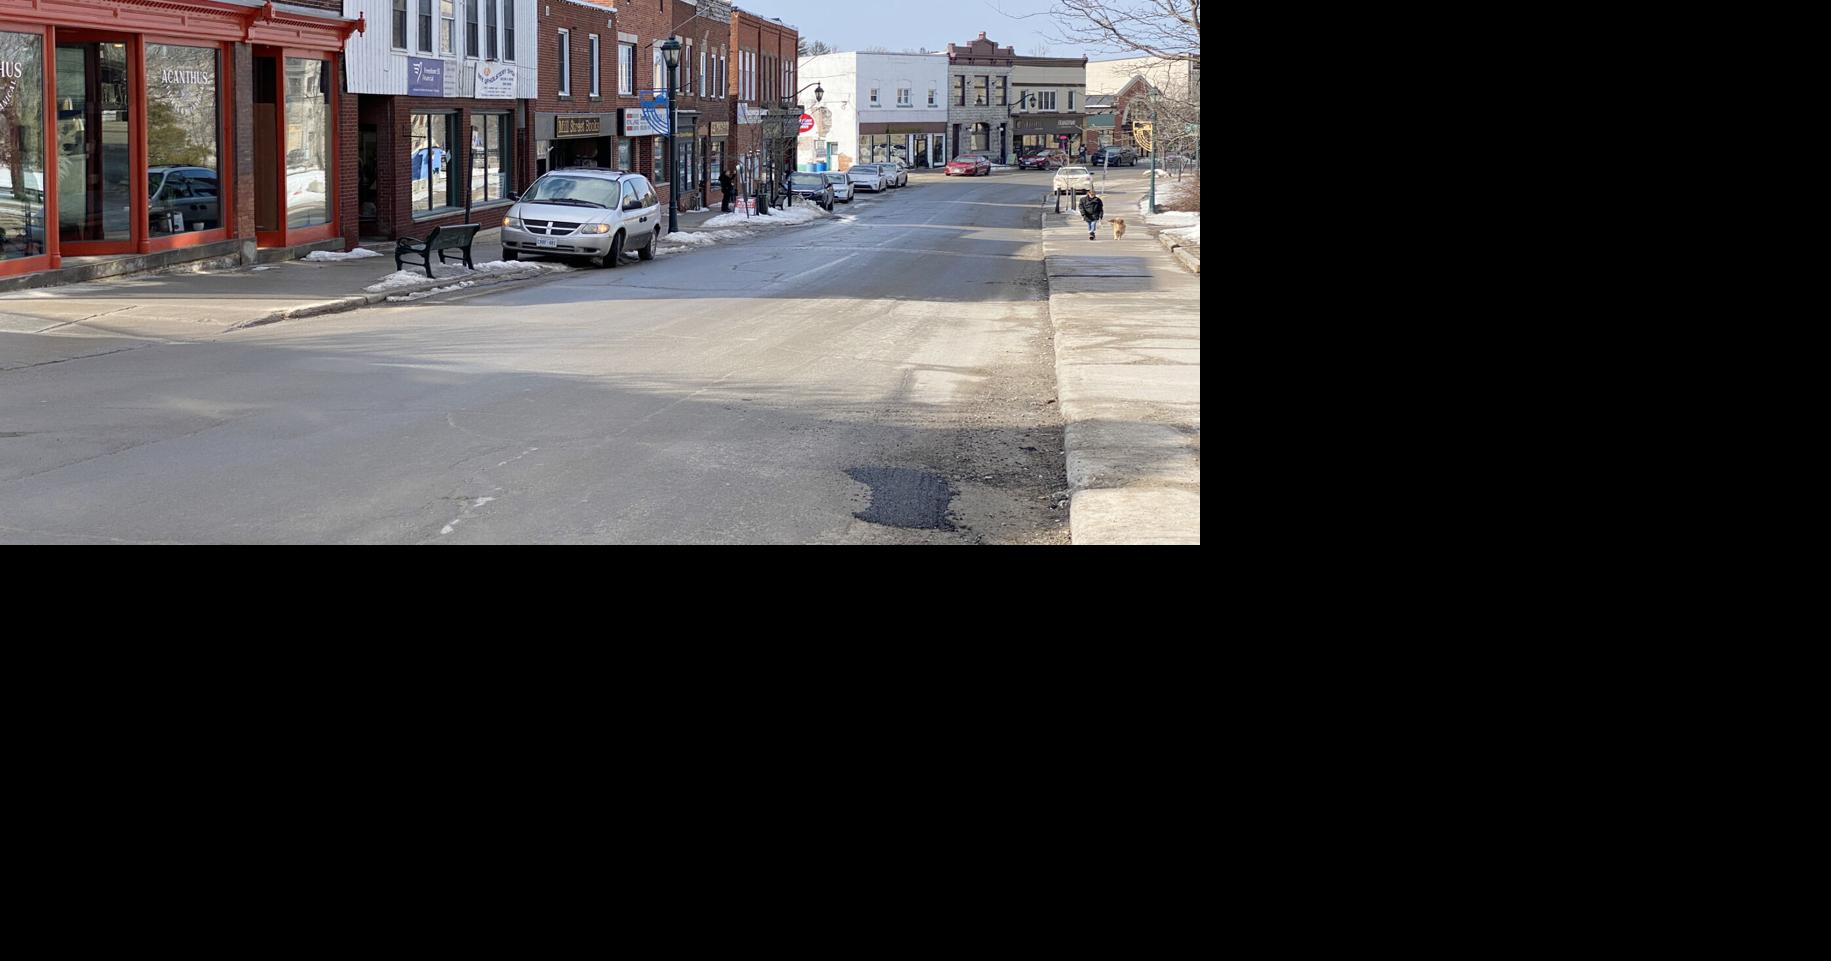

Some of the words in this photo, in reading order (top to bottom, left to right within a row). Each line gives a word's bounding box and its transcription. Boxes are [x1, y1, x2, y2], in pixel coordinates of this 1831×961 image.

[161, 69, 209, 85] ACANTHUS
[558, 119, 569, 133] Mill
[570, 119, 585, 133] Street
[585, 119, 600, 132] Books
